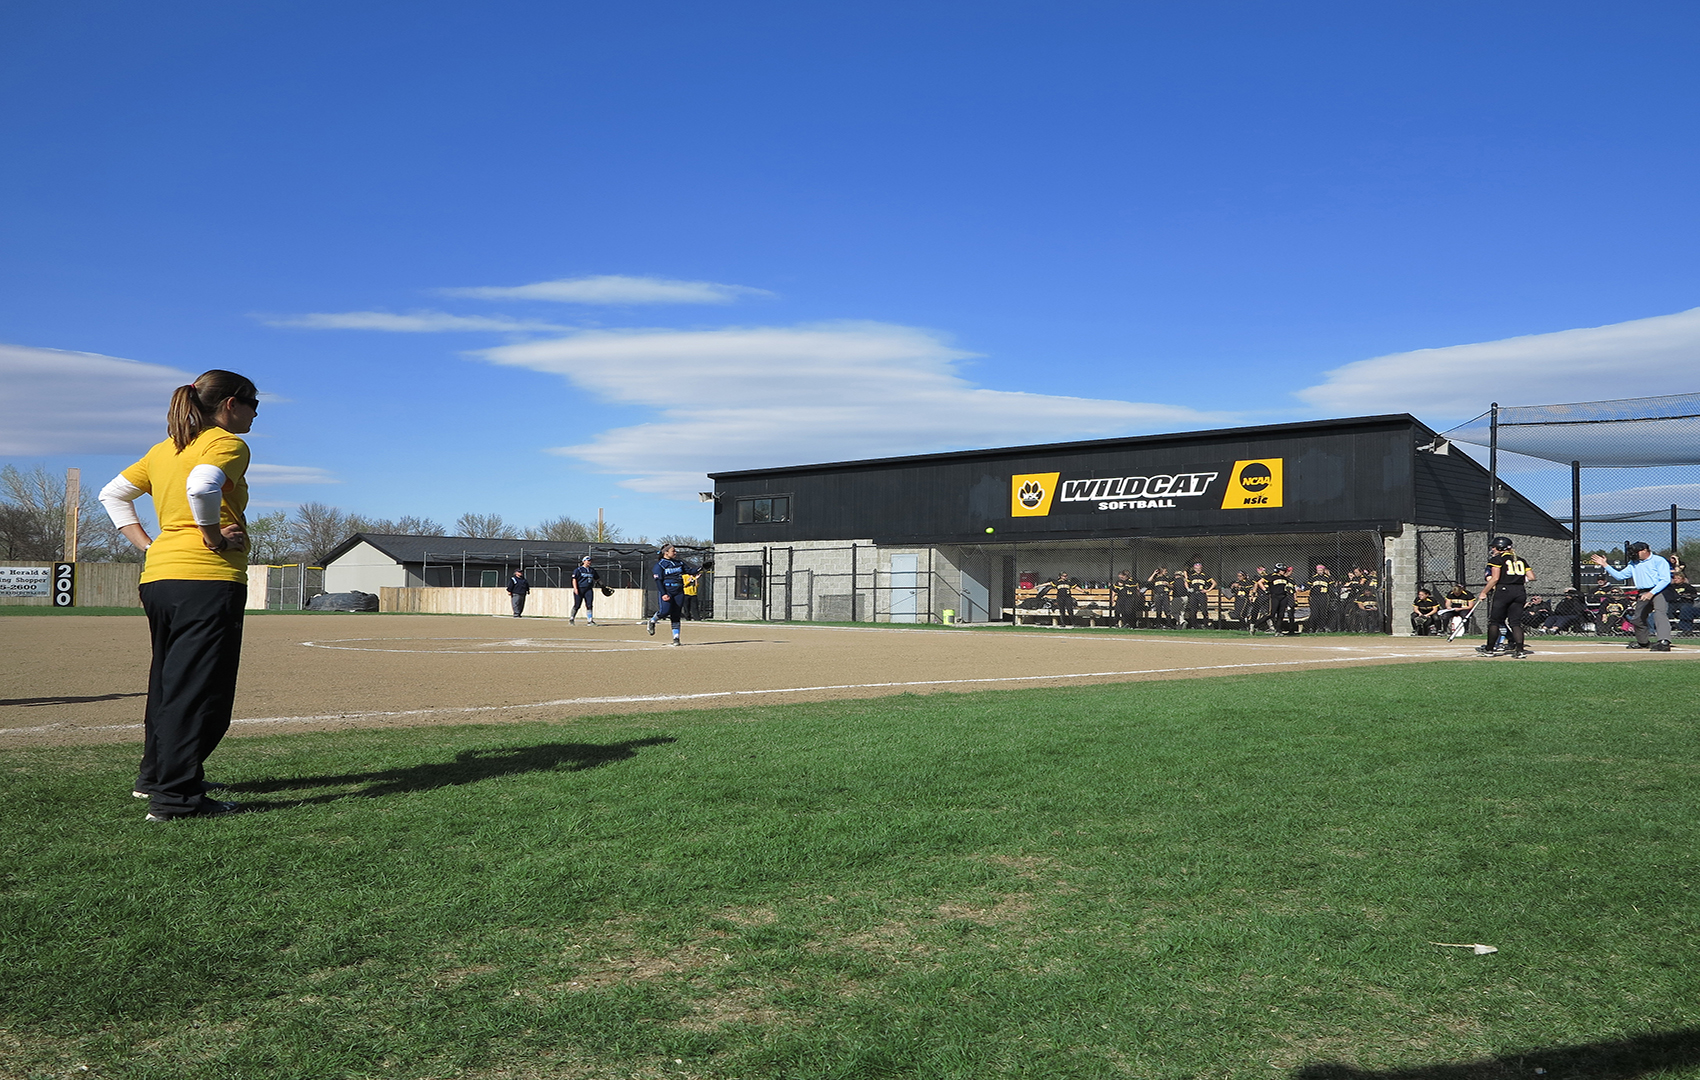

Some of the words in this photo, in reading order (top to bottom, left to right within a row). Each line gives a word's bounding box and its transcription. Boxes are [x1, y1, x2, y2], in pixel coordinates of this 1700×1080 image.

[1061, 472, 1218, 502] WILDCAT
[1242, 476, 1271, 486] NCAA
[1098, 499, 1176, 511] SOFTBALL
[1506, 560, 1525, 576] 10
[57, 564, 72, 606] 200
